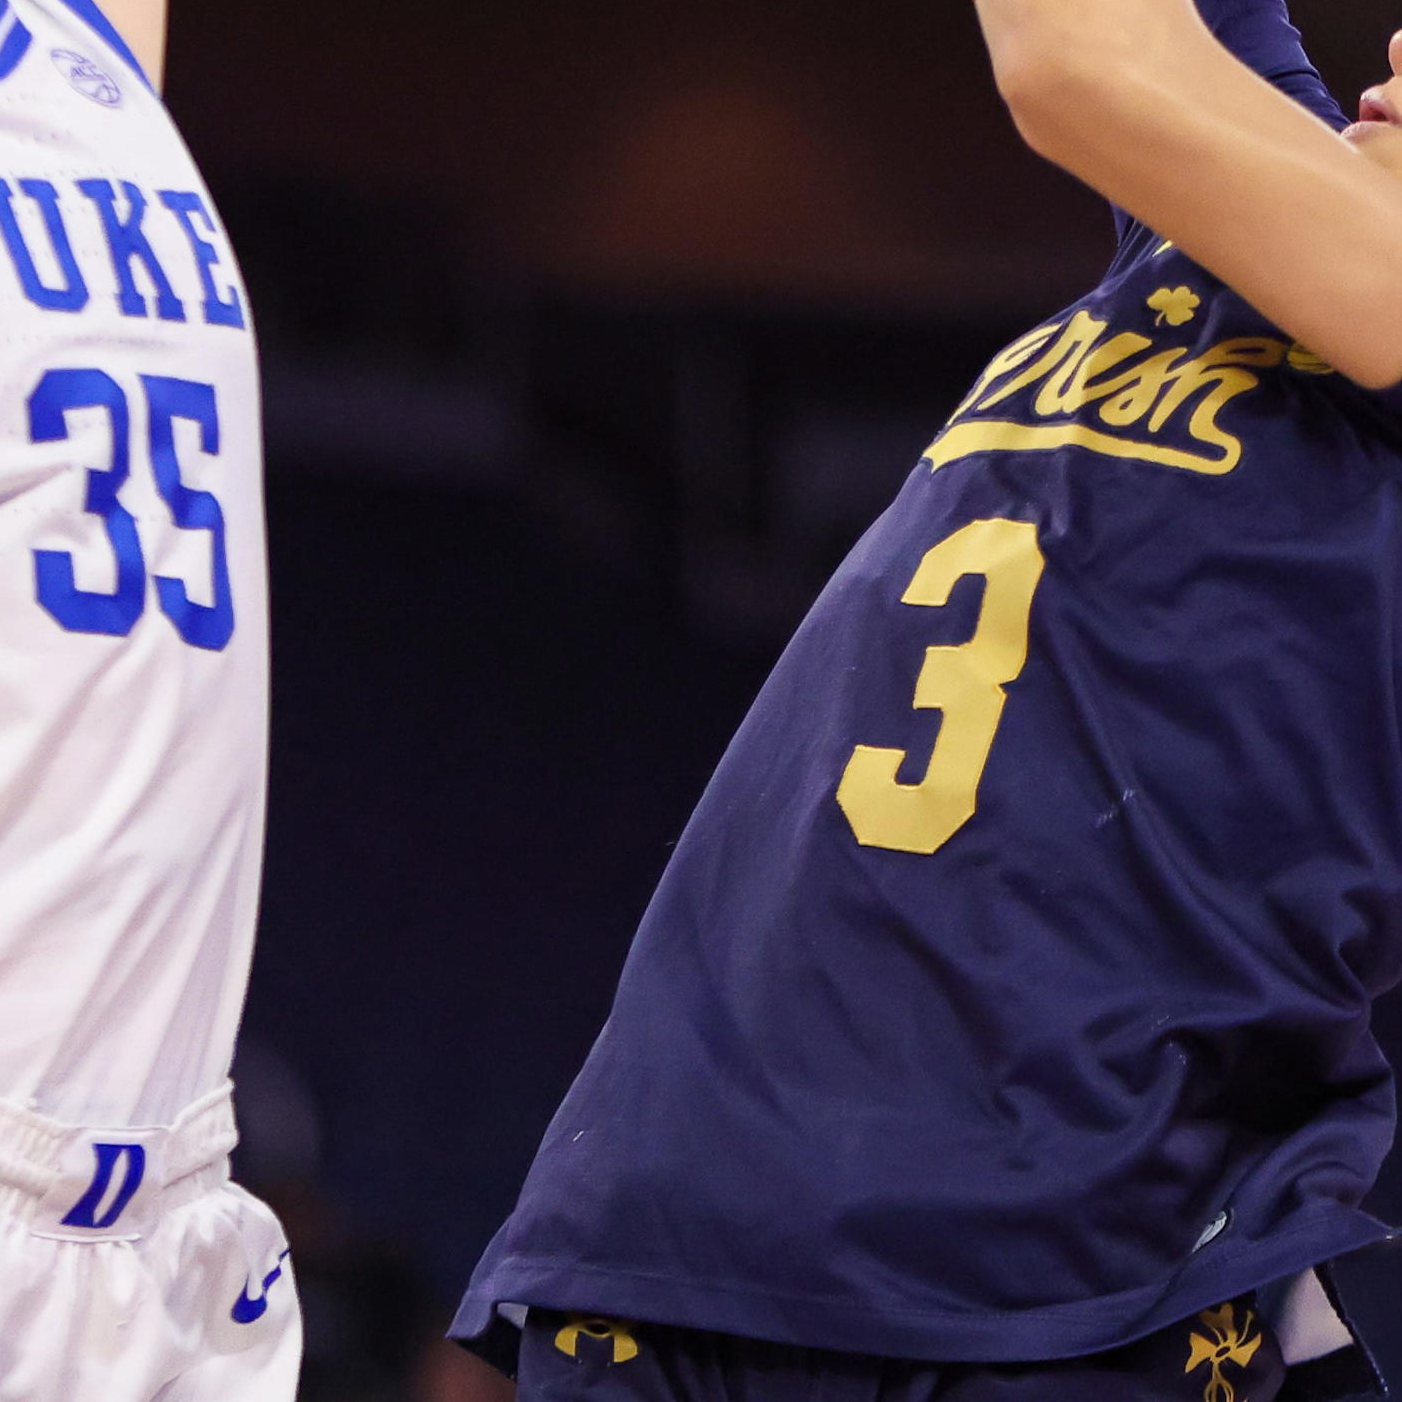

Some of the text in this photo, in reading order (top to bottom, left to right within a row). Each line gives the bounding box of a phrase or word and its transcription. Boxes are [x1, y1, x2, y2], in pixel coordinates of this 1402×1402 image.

[27, 366, 235, 653] 35
[836, 517, 1045, 855] 3
[59, 1142, 146, 1229] D
